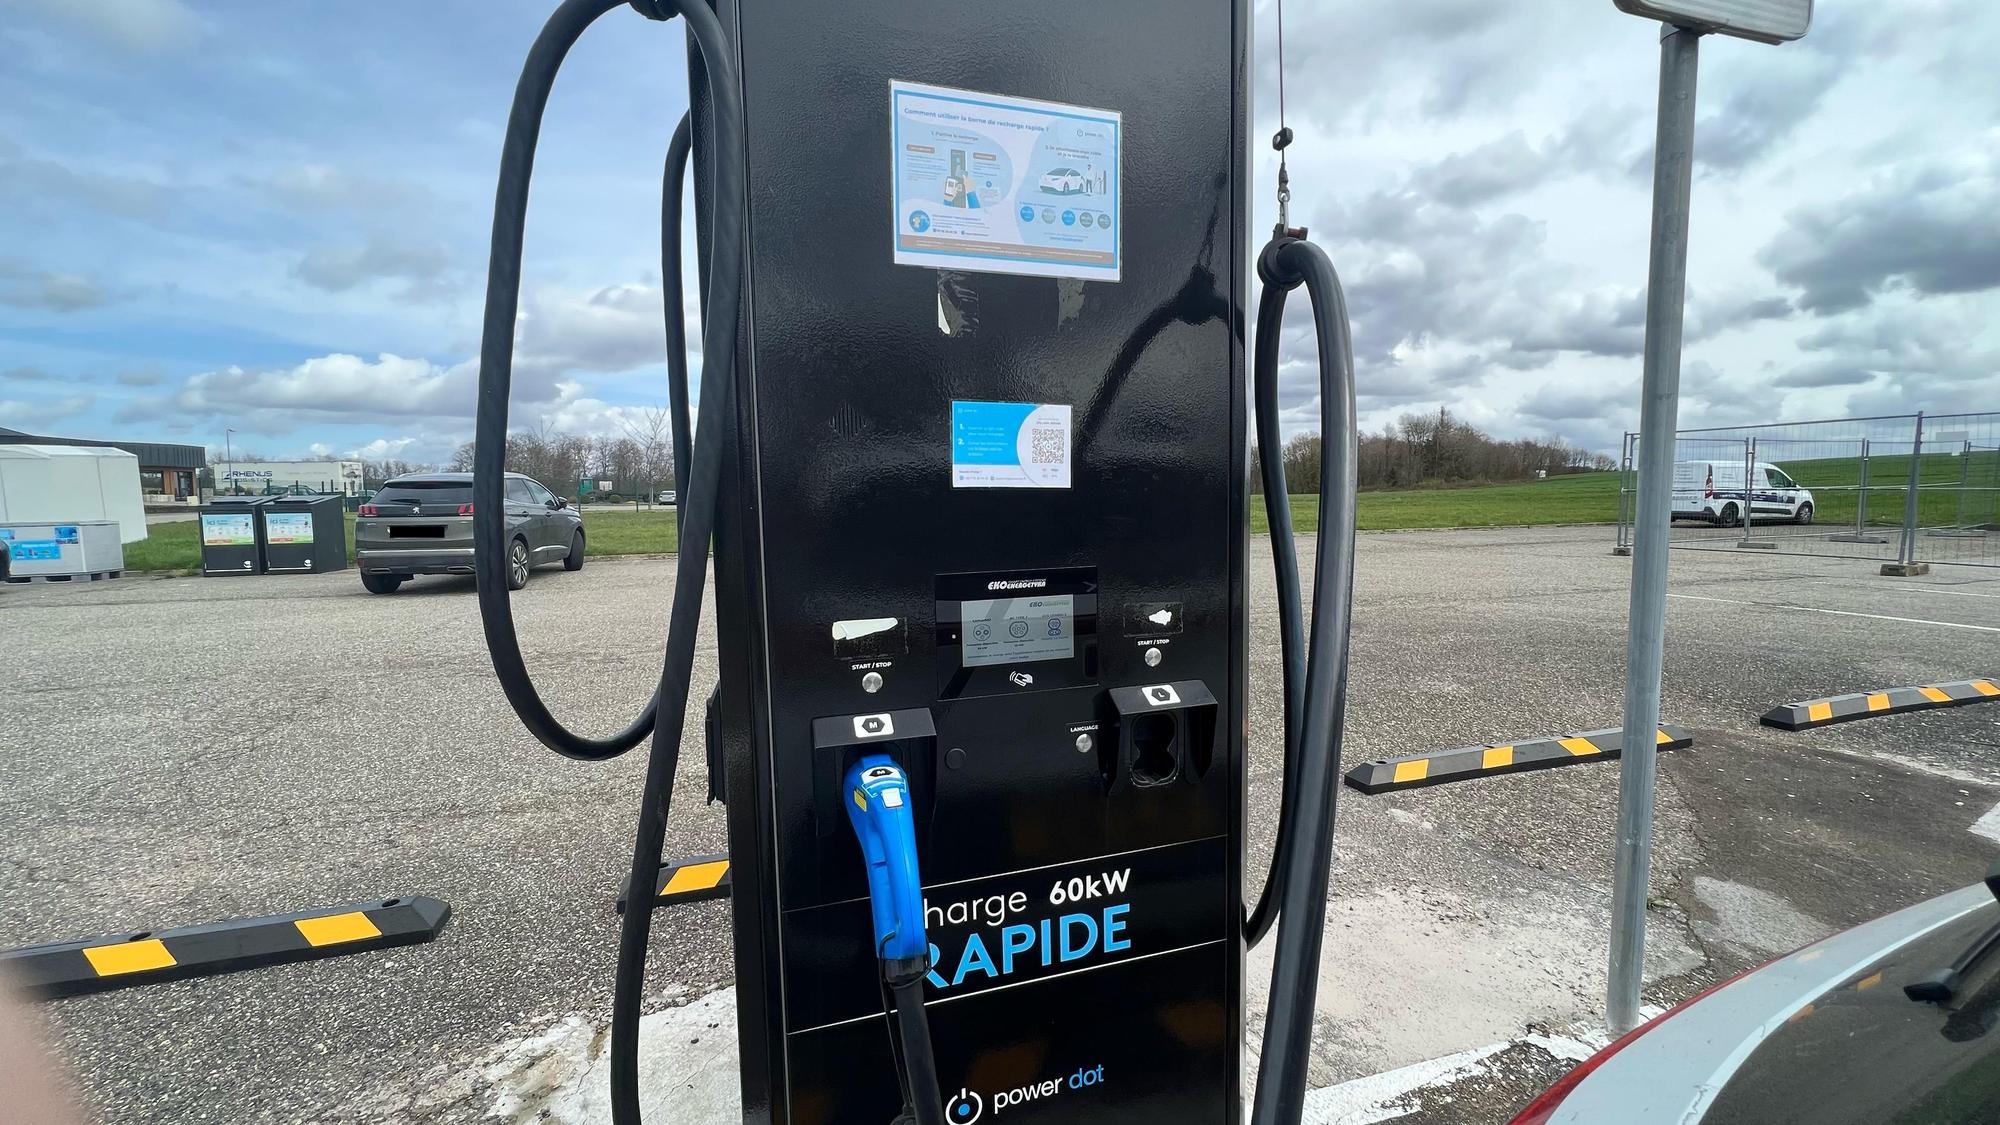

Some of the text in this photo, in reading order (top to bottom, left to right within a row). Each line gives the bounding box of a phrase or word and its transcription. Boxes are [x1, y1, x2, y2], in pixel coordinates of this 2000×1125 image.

[904, 107, 937, 118] Comment
[937, 113, 960, 121] utiliser
[997, 120, 1025, 130] recharge
[851, 662, 871, 670] START
[875, 661, 892, 669] STOP
[868, 720, 878, 729] M
[1070, 724, 1099, 733] LANGUAGE
[923, 868, 1131, 929] harge 60kW
[993, 1063, 1105, 1115] power dot
